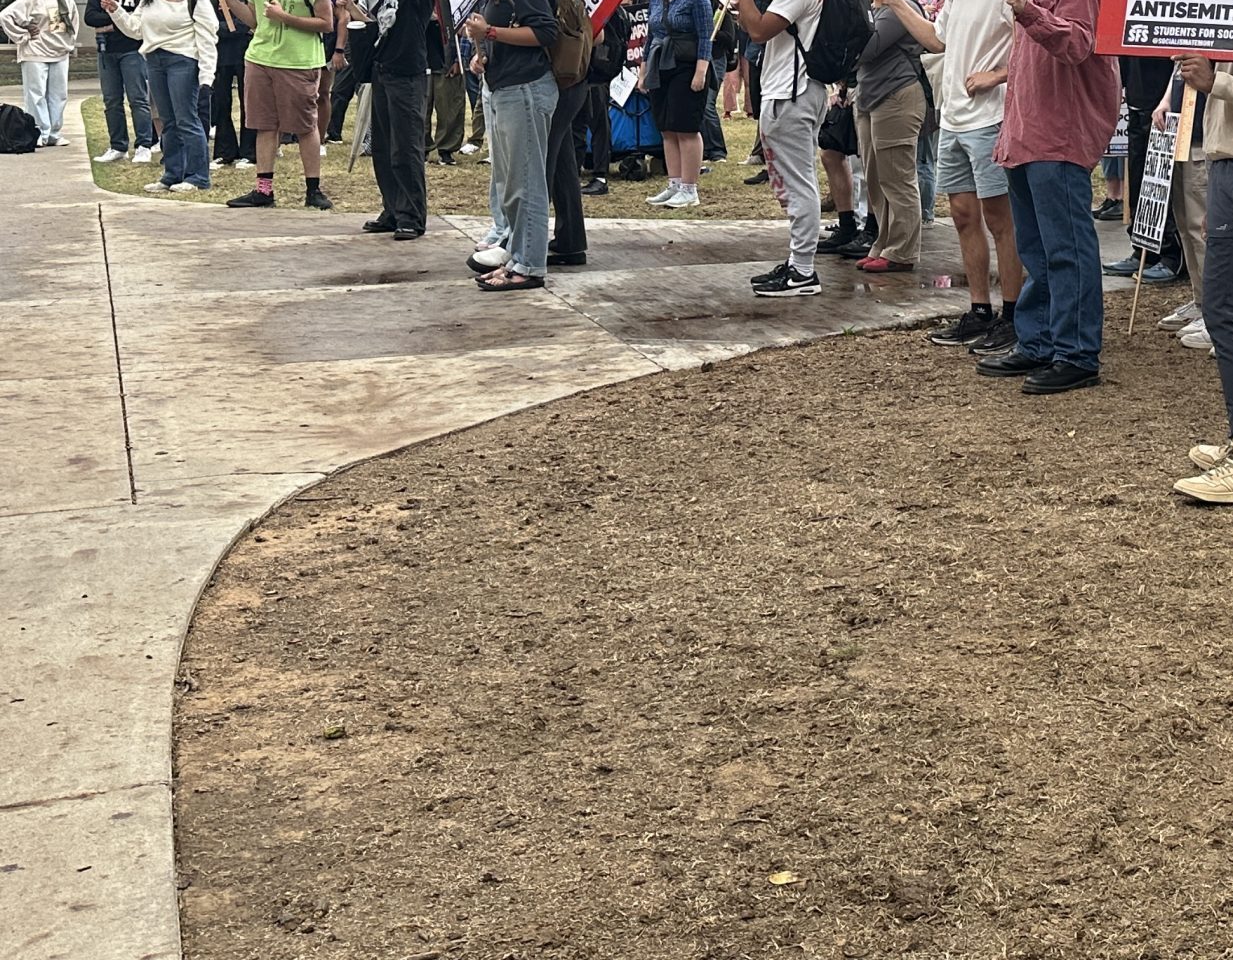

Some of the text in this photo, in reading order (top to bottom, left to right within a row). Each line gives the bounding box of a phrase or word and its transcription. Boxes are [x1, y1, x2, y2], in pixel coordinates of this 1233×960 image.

[1127, 28, 1149, 43] SFS
[1152, 25, 1197, 37] STUDENTS
[1198, 27, 1215, 38] FOR
[1133, 196, 1166, 240] NOW!
